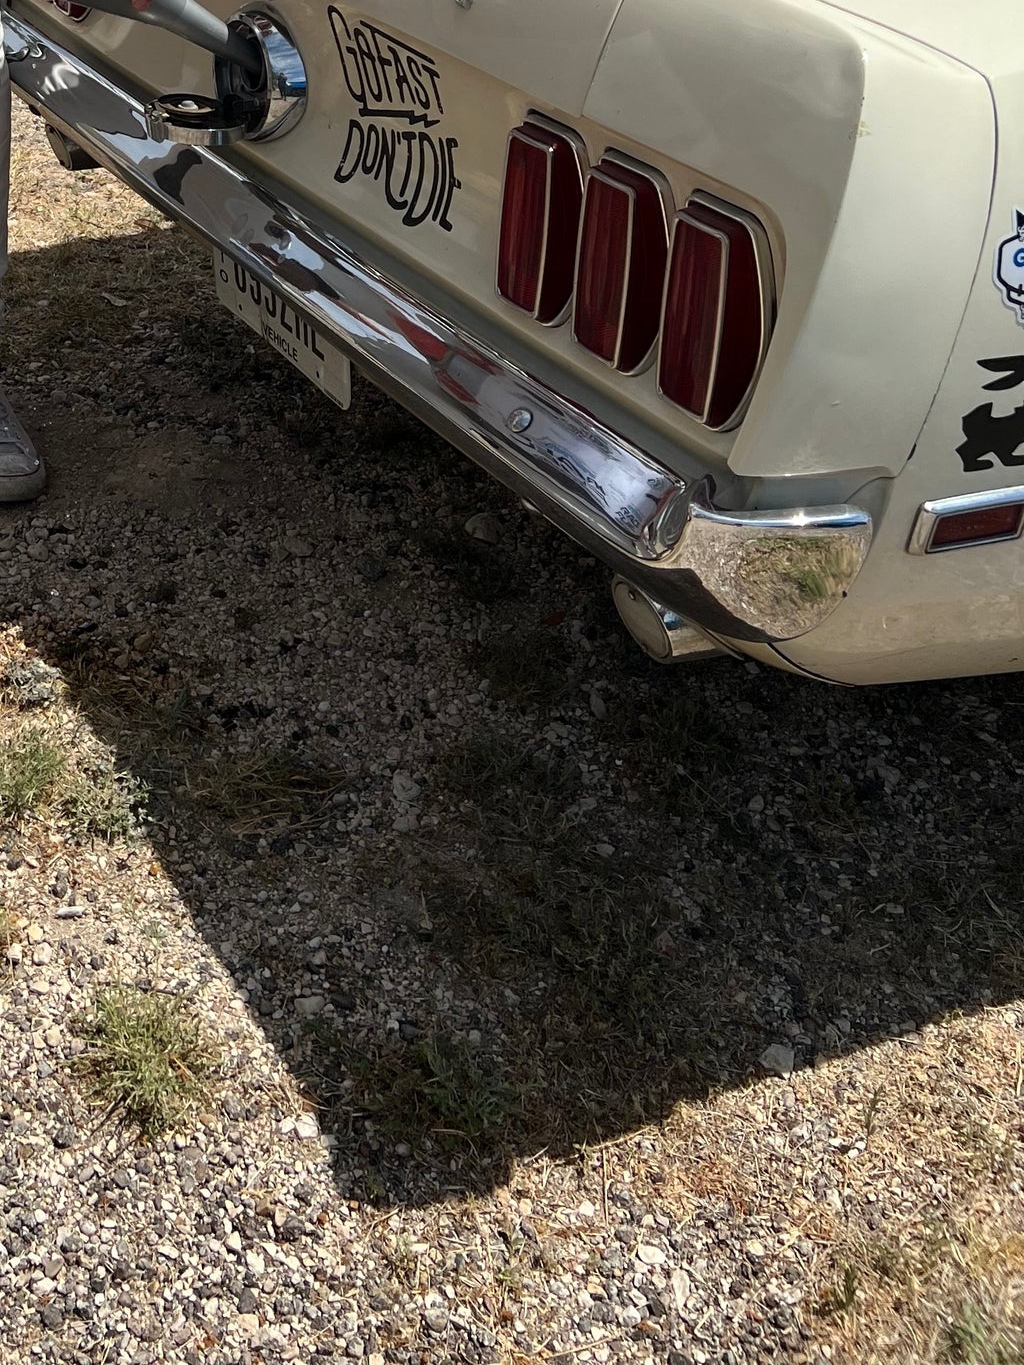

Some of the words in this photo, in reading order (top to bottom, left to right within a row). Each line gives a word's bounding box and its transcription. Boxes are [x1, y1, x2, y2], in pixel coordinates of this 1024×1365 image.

[334, 119, 418, 211] DON'T
[402, 132, 462, 233] DIE
[262, 321, 299, 363] VEHICLE
